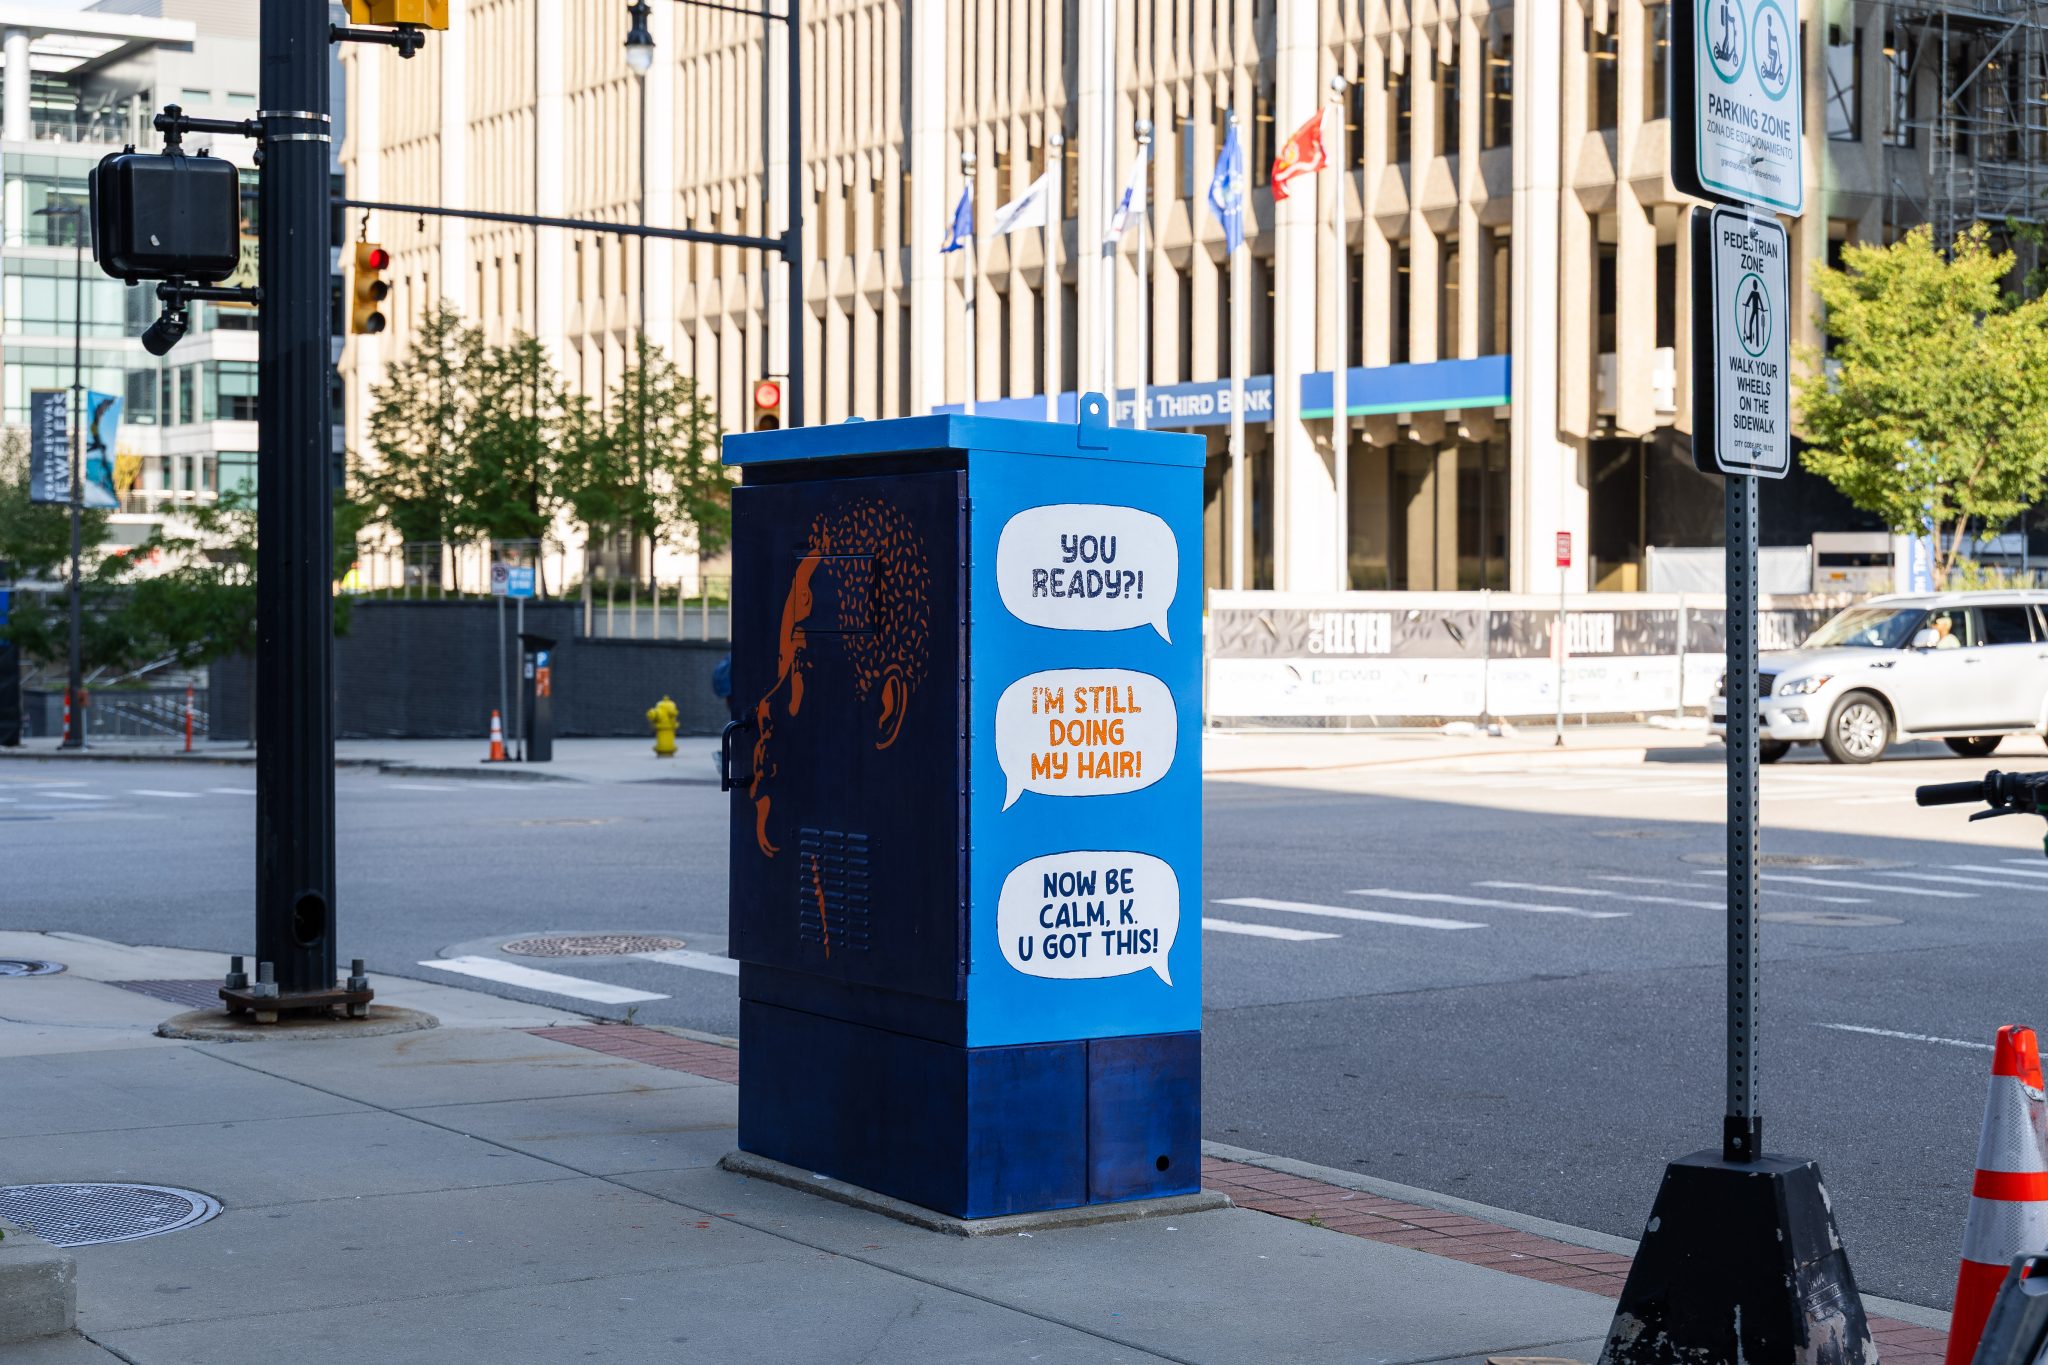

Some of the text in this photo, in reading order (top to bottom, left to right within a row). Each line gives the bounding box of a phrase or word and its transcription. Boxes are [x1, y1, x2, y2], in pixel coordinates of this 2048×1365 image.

[1708, 92, 1791, 142] PARKING ZONE
[1707, 119, 1793, 160] ZONA DE ESTACIONAMIENTO
[1723, 230, 1778, 259] PEDESTRIAN
[1740, 253, 1765, 274] ZONE
[1729, 355, 1778, 379] WALK YOUR
[1736, 376, 1771, 396] WHEELS
[1156, 394, 1214, 418] THIRD
[1217, 389, 1273, 414] BNK
[1739, 395, 1769, 415] ON THE
[1733, 413, 1775, 434] SIDEWALK
[1060, 533, 1117, 564] YOU
[1031, 567, 1144, 599] READY?!
[1324, 611, 1392, 654] ELEVEN
[1565, 611, 1615, 653] ELEVEN
[1031, 685, 1142, 714] I'M STILL
[1049, 718, 1125, 746] DOING
[1031, 751, 1142, 780] MY HAIR!
[1043, 868, 1135, 898] NOW BE
[1039, 898, 1138, 929] CALM, K.
[1018, 928, 1159, 962] U GOT THIS!
